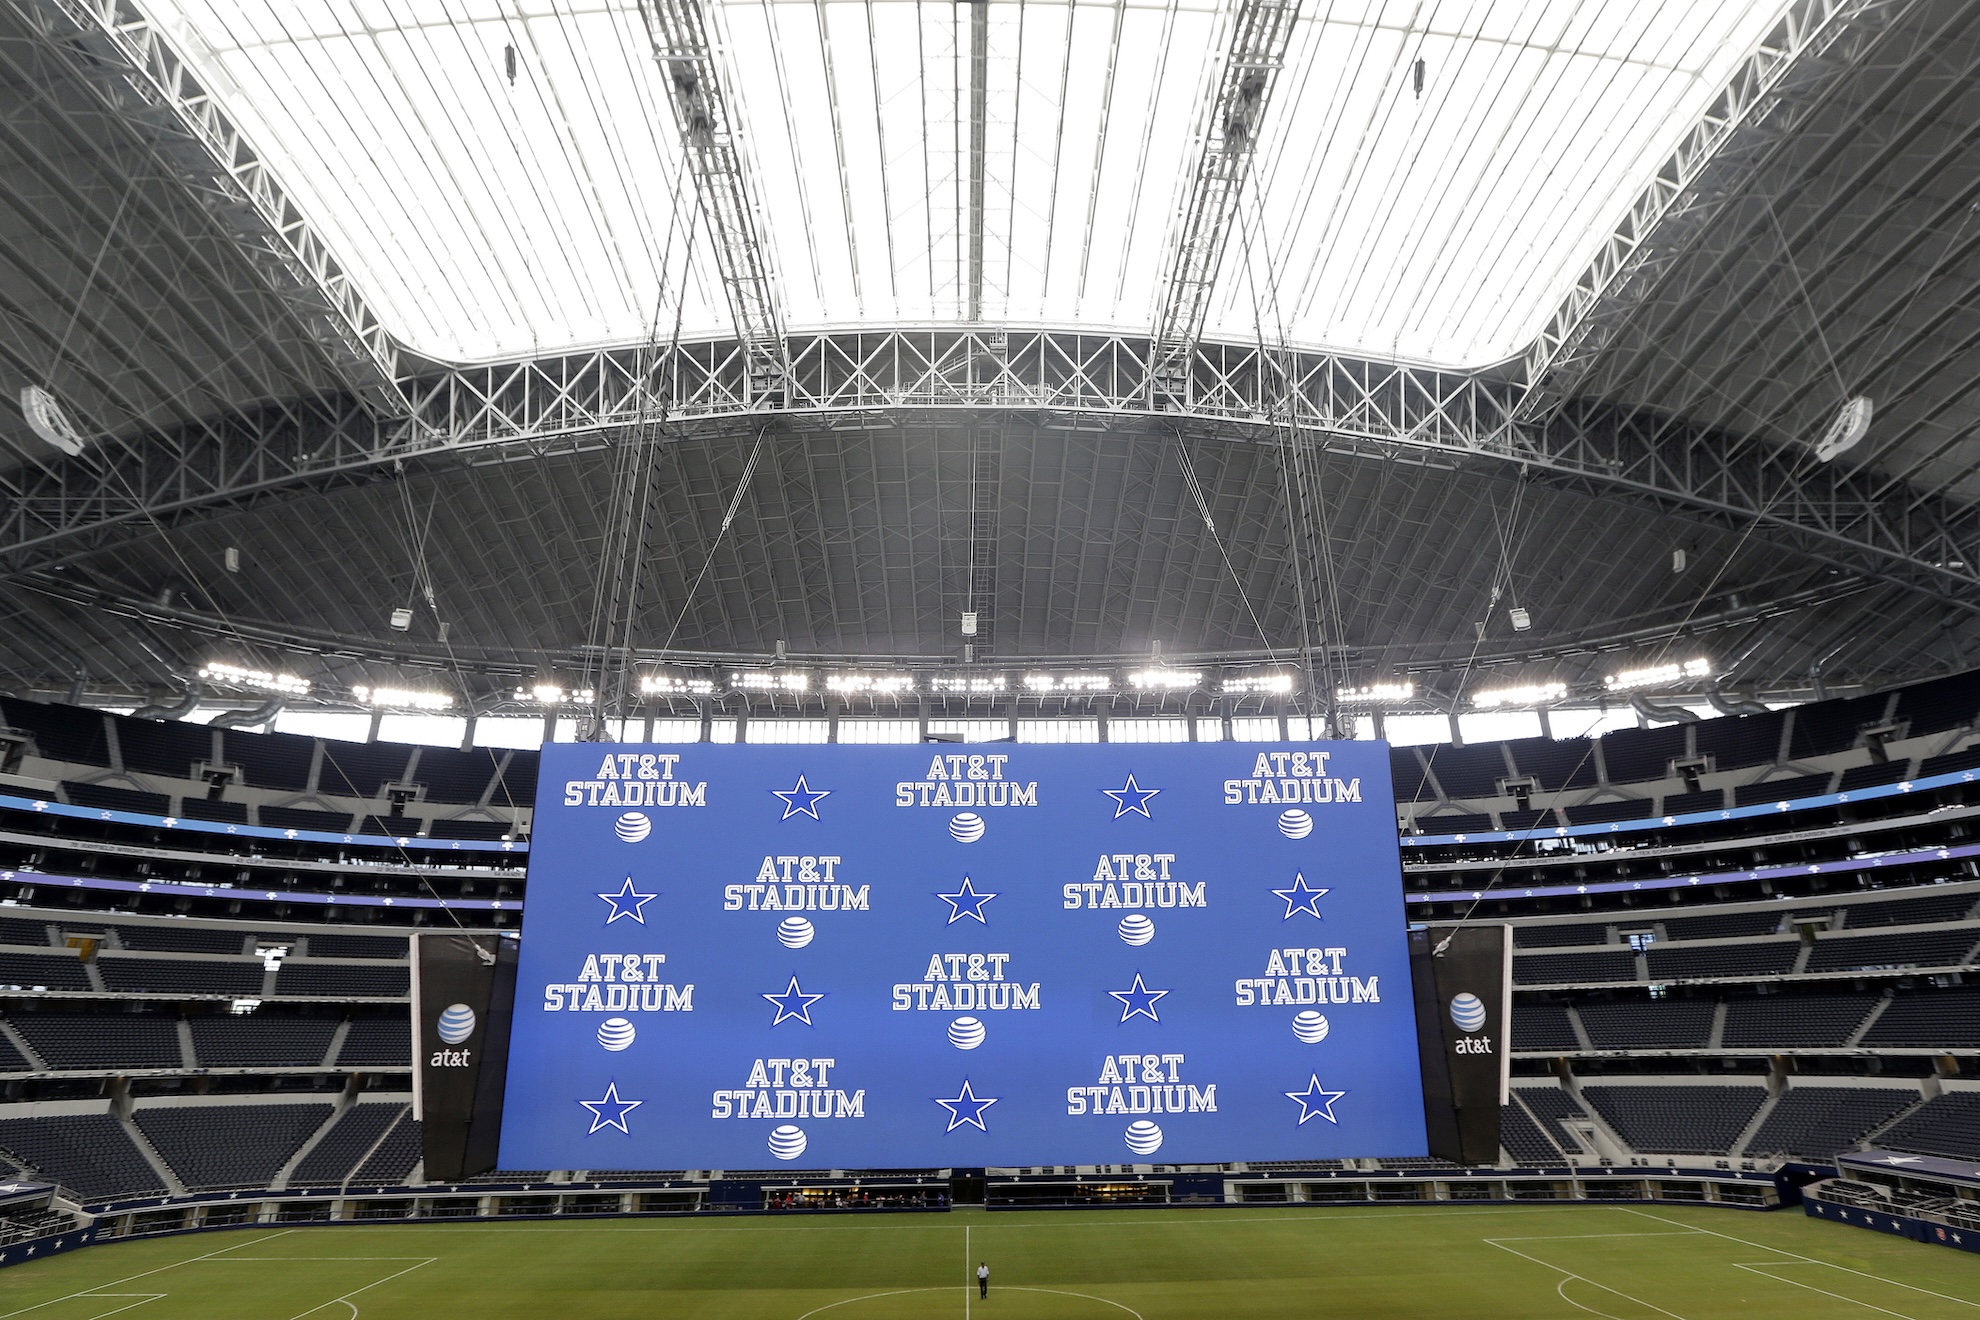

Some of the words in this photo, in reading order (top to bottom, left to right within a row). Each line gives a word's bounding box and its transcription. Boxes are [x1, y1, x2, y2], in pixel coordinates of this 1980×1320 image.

[596, 753, 680, 780] AT&T
[926, 754, 1009, 781] AT&T
[1252, 751, 1331, 778] AT&T
[564, 780, 708, 807] STADIUM
[896, 781, 1038, 807] STADIUM
[1223, 778, 1362, 805] STADIUM
[755, 855, 841, 883] AT&T
[1093, 853, 1176, 881] AT&T
[723, 884, 870, 911] STADIUM
[1063, 882, 1207, 909] STADIUM
[577, 954, 666, 982] AT&T
[923, 953, 1010, 982] AT&T
[1264, 947, 1347, 977] AT&T
[543, 983, 695, 1012] STADIUM
[892, 982, 1041, 1011] STADIUM
[1235, 976, 1381, 1006] STADIUM
[430, 1048, 471, 1067] at&t
[1455, 1036, 1493, 1054] at&t
[745, 1058, 835, 1088] AT&T
[1098, 1053, 1185, 1084] AT&T
[712, 1089, 866, 1119] STADIUM
[1067, 1084, 1218, 1115] STADIUM
